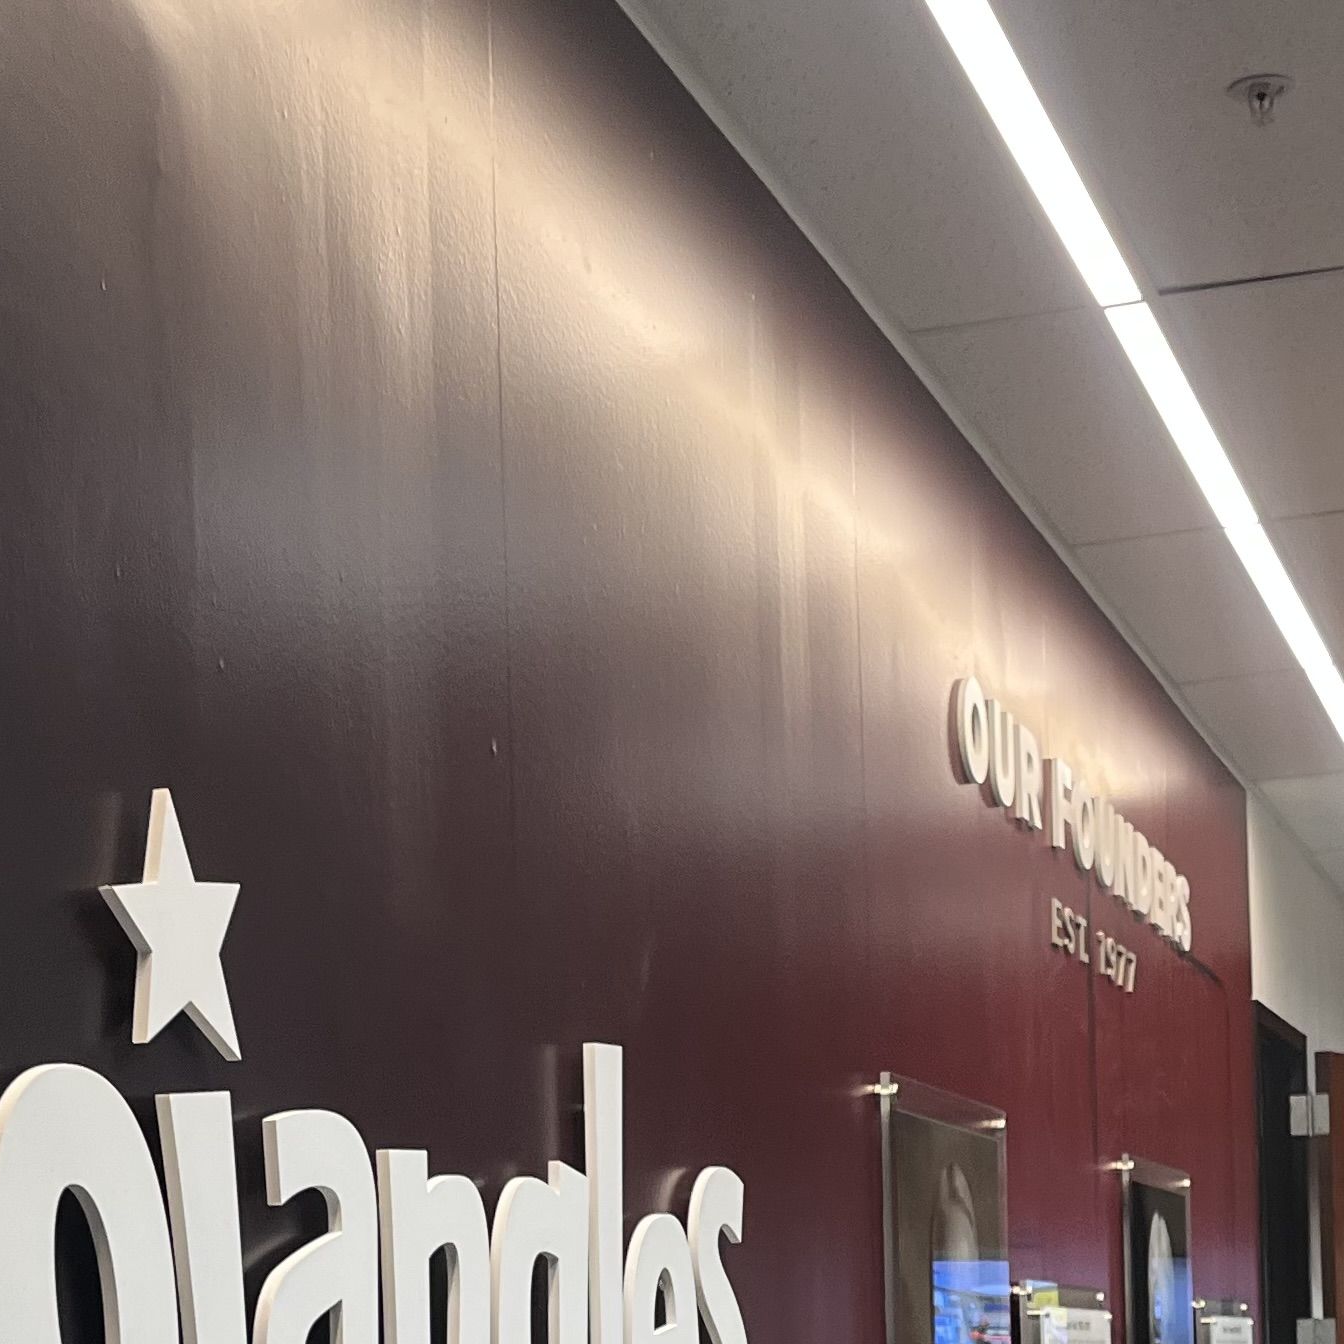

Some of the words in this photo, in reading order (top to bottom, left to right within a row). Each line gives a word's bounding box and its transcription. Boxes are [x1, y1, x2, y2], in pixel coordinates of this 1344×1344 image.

[957, 675, 1043, 830] OUR
[1051, 757, 1192, 952] FOUNDERS
[1096, 930, 1137, 993] 1977
